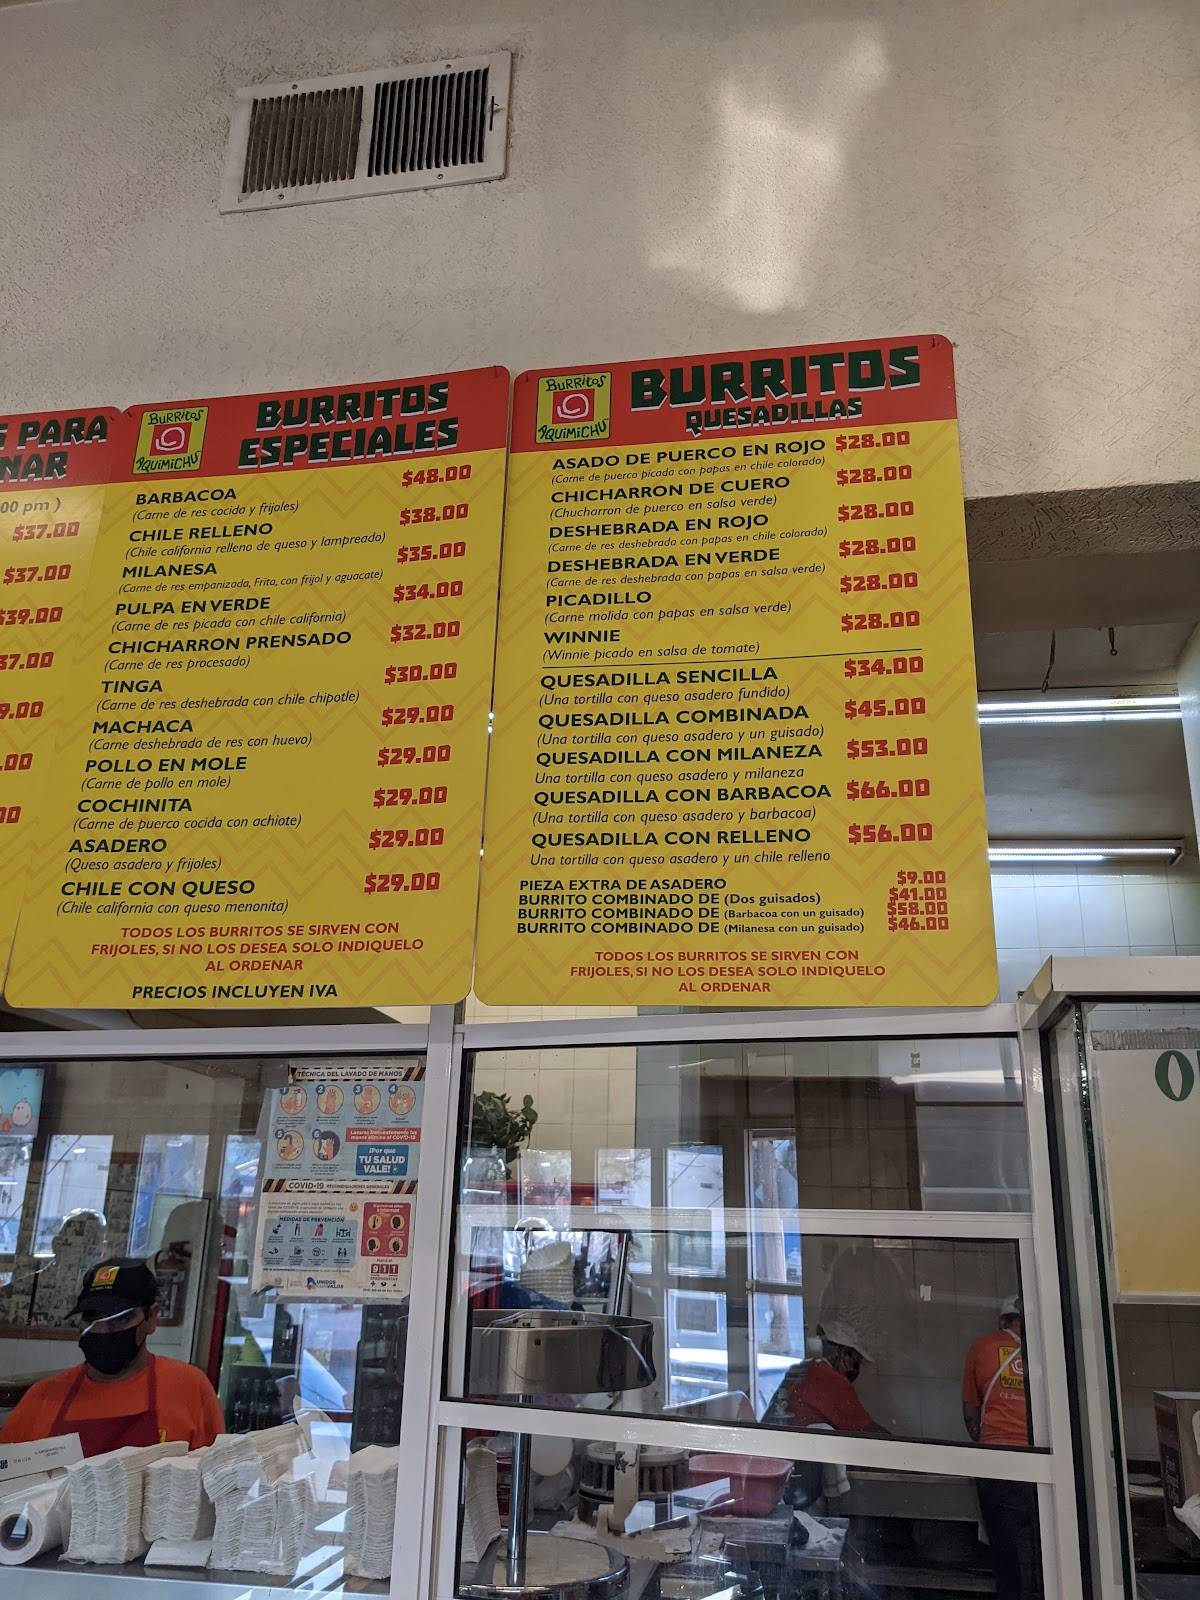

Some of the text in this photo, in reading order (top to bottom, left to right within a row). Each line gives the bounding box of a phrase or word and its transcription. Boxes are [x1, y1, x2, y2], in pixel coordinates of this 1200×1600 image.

[631, 347, 921, 411] BURRITOS
[256, 382, 449, 433] BURRITOS
[686, 398, 862, 437] QUESADILLAS
[17, 416, 108, 449] PARA
[238, 418, 459, 468] ESPECIALES
[835, 430, 910, 452] $28.00
[552, 439, 826, 470] ASADO DE PUERCO EN ROJO
[401, 464, 472, 489] $48.00
[836, 464, 912, 487] $28.00
[135, 488, 237, 505] BARBACOA
[551, 476, 790, 503] CHICHARRON DE CUERO
[23, 502, 49, 515] pm
[399, 503, 469, 527] $38.00
[625, 504, 640, 514] de
[643, 503, 684, 516] puerco
[688, 502, 702, 510] en
[706, 498, 736, 509] salsa
[740, 494, 777, 508] verde)
[838, 501, 914, 523] $28.00
[12, 522, 80, 542] $37.00
[129, 523, 273, 542] CHILE RELLENO
[549, 514, 769, 539] DESHEBRADA EN ROJO
[397, 541, 466, 565] $35.00
[839, 536, 916, 559] $28.00
[122, 562, 217, 578] MILANESA
[547, 548, 780, 573] DESHEBRADA EN VERDE
[3, 564, 71, 586] $37.00
[840, 572, 918, 595] $28.00
[393, 580, 463, 604] $34.00
[546, 591, 652, 607] PICADILLO
[115, 597, 271, 616] PULPA EN VERDE
[390, 620, 460, 644] $32.00
[841, 610, 920, 633] $28.00
[108, 631, 352, 654] CHICHARRON PRENSADO
[543, 629, 620, 644] WINNIE
[384, 662, 457, 686] $30.00
[540, 667, 778, 691] QUESADILLA SENCILLA
[844, 656, 924, 679] $34.00
[101, 680, 163, 694] TINGA
[381, 704, 455, 728] $29.00
[538, 705, 809, 730] QUESADILLA COMBINADA
[844, 697, 926, 720] $45.00
[92, 719, 193, 734] MACHACA
[377, 744, 451, 768] $29.00
[536, 744, 823, 768] QUESADILLA CON MILANEZA
[847, 737, 928, 760] $53.00
[85, 756, 247, 773] POLLO EN MOLE
[373, 786, 448, 809] $29.00
[534, 784, 832, 807] QUESADILLA CON BARBACOA
[847, 778, 930, 801] $66.00
[77, 798, 192, 813] COCHINITA
[369, 827, 444, 851] $29.00
[531, 828, 811, 849] QUESADILLA CON RELLENO
[848, 822, 932, 845] $56.00
[68, 838, 167, 853] ASADERO
[61, 880, 255, 898] CHILE CON QUESO
[364, 872, 441, 895] $29.00
[520, 878, 726, 891] PIEZA EXTRA DE ASADERO
[897, 869, 946, 886] $9.00
[519, 892, 821, 907] BURRITO COMBINADO DE (Dos guisados)
[889, 887, 948, 903] $41.00
[518, 908, 587, 919] BURRITO
[591, 907, 694, 919] COMBINADO
[698, 907, 720, 919] DE
[724, 909, 778, 921] (Barbacoa
[819, 907, 864, 919] guisado)
[887, 901, 949, 918] $58.00
[517, 922, 586, 934] BURRITO
[590, 922, 694, 934] COMBINADO
[698, 922, 720, 933] DE
[724, 924, 775, 935] (Milanesa
[778, 925, 798, 933] con
[818, 922, 864, 934] guisado)
[887, 916, 950, 933] $46.00
[205, 959, 303, 972] AL ORDENAR
[132, 984, 338, 999] PRECIOS INCLUYEN IVA
[359, 1156, 406, 1164] TU SALUD
[364, 1165, 391, 1173] VALE!
[372, 1265, 397, 1273] 911
